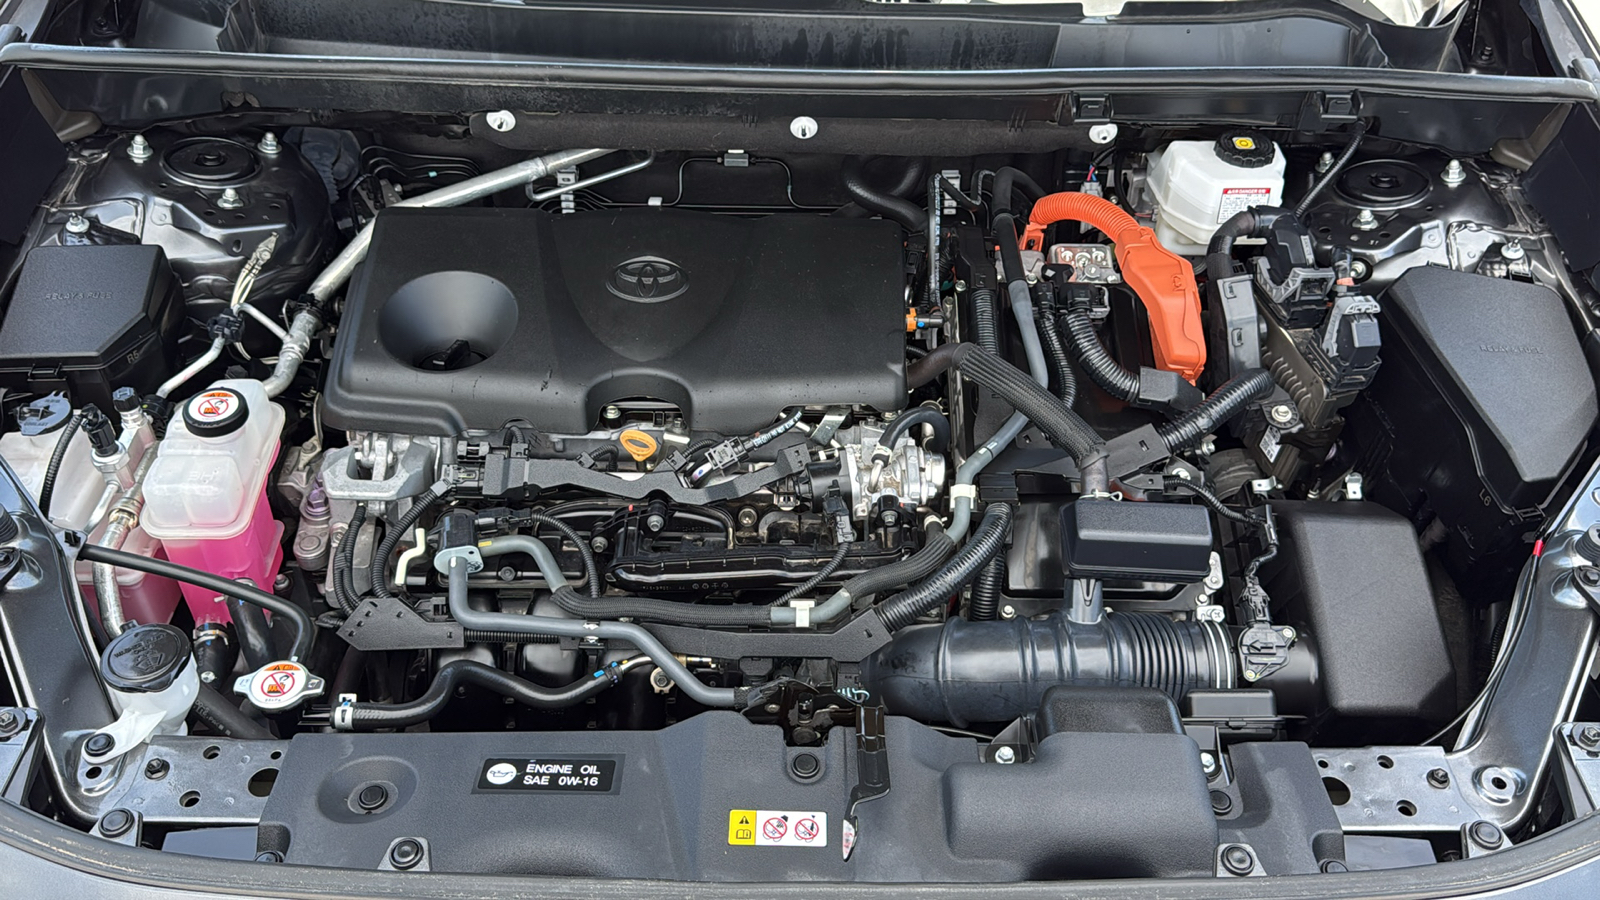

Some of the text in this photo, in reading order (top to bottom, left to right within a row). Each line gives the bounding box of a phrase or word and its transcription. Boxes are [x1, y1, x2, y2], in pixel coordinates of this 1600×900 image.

[1479, 488, 1492, 506] L6
[526, 764, 601, 775] ENGINE OIL
[523, 775, 599, 786] SAE 0W-16
